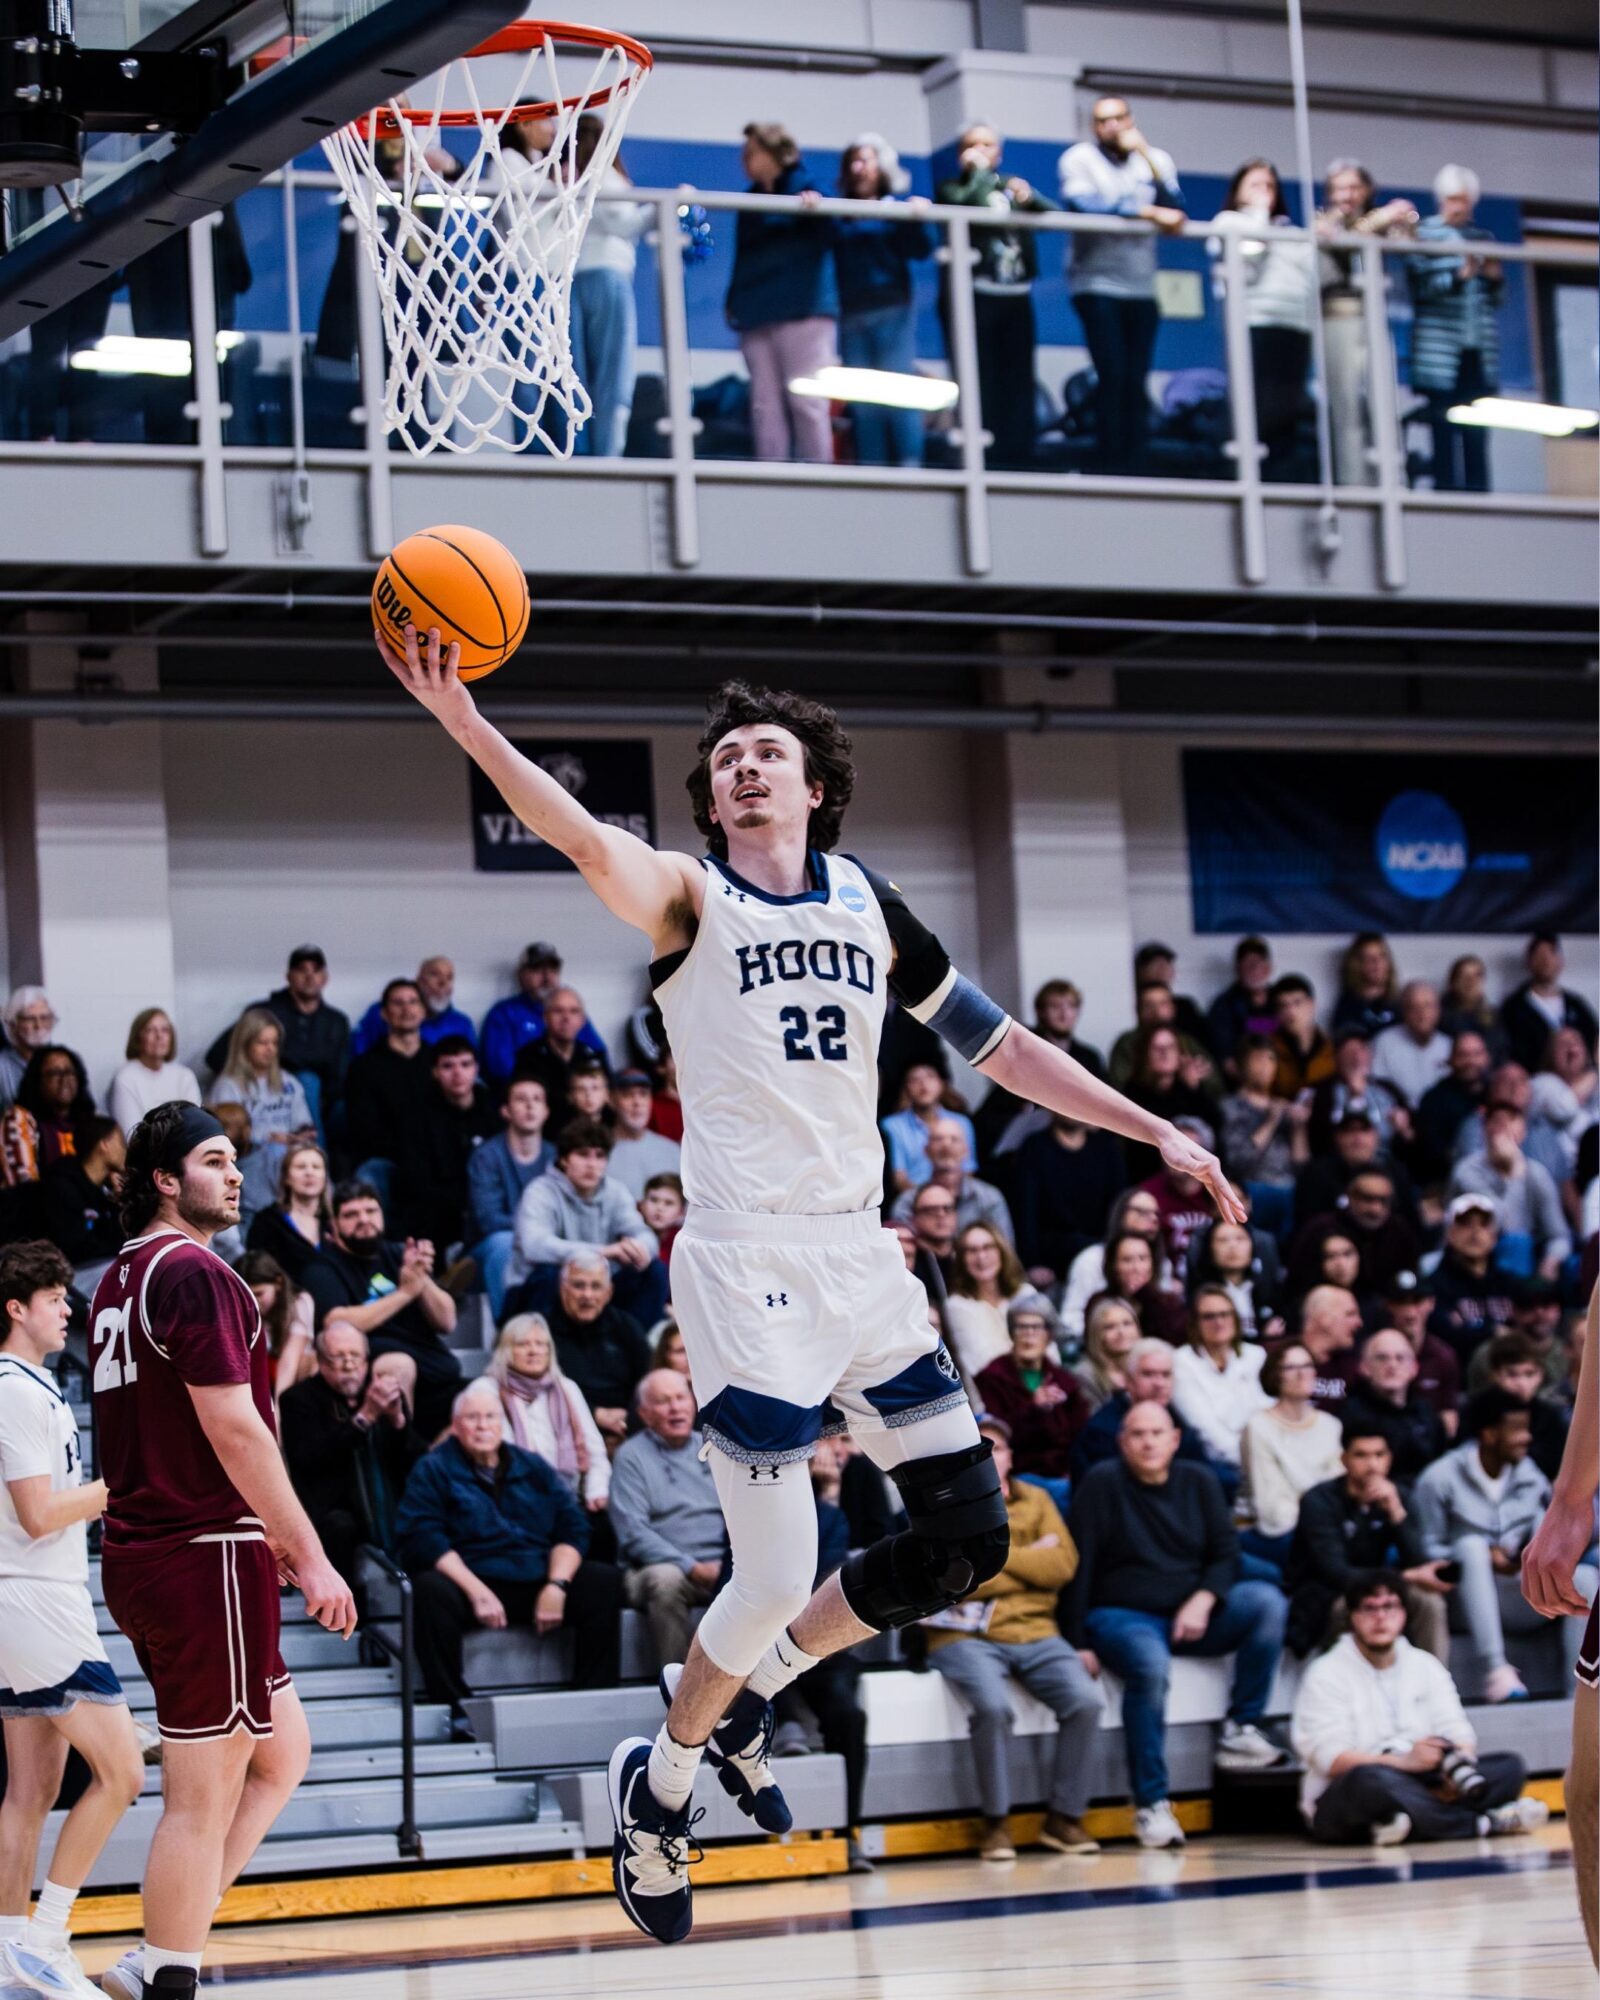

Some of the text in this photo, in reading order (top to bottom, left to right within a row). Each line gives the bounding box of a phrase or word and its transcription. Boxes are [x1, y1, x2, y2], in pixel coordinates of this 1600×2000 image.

[735, 939, 874, 996] HOOD
[780, 1005, 848, 1061] 22
[93, 1296, 138, 1393] 21
